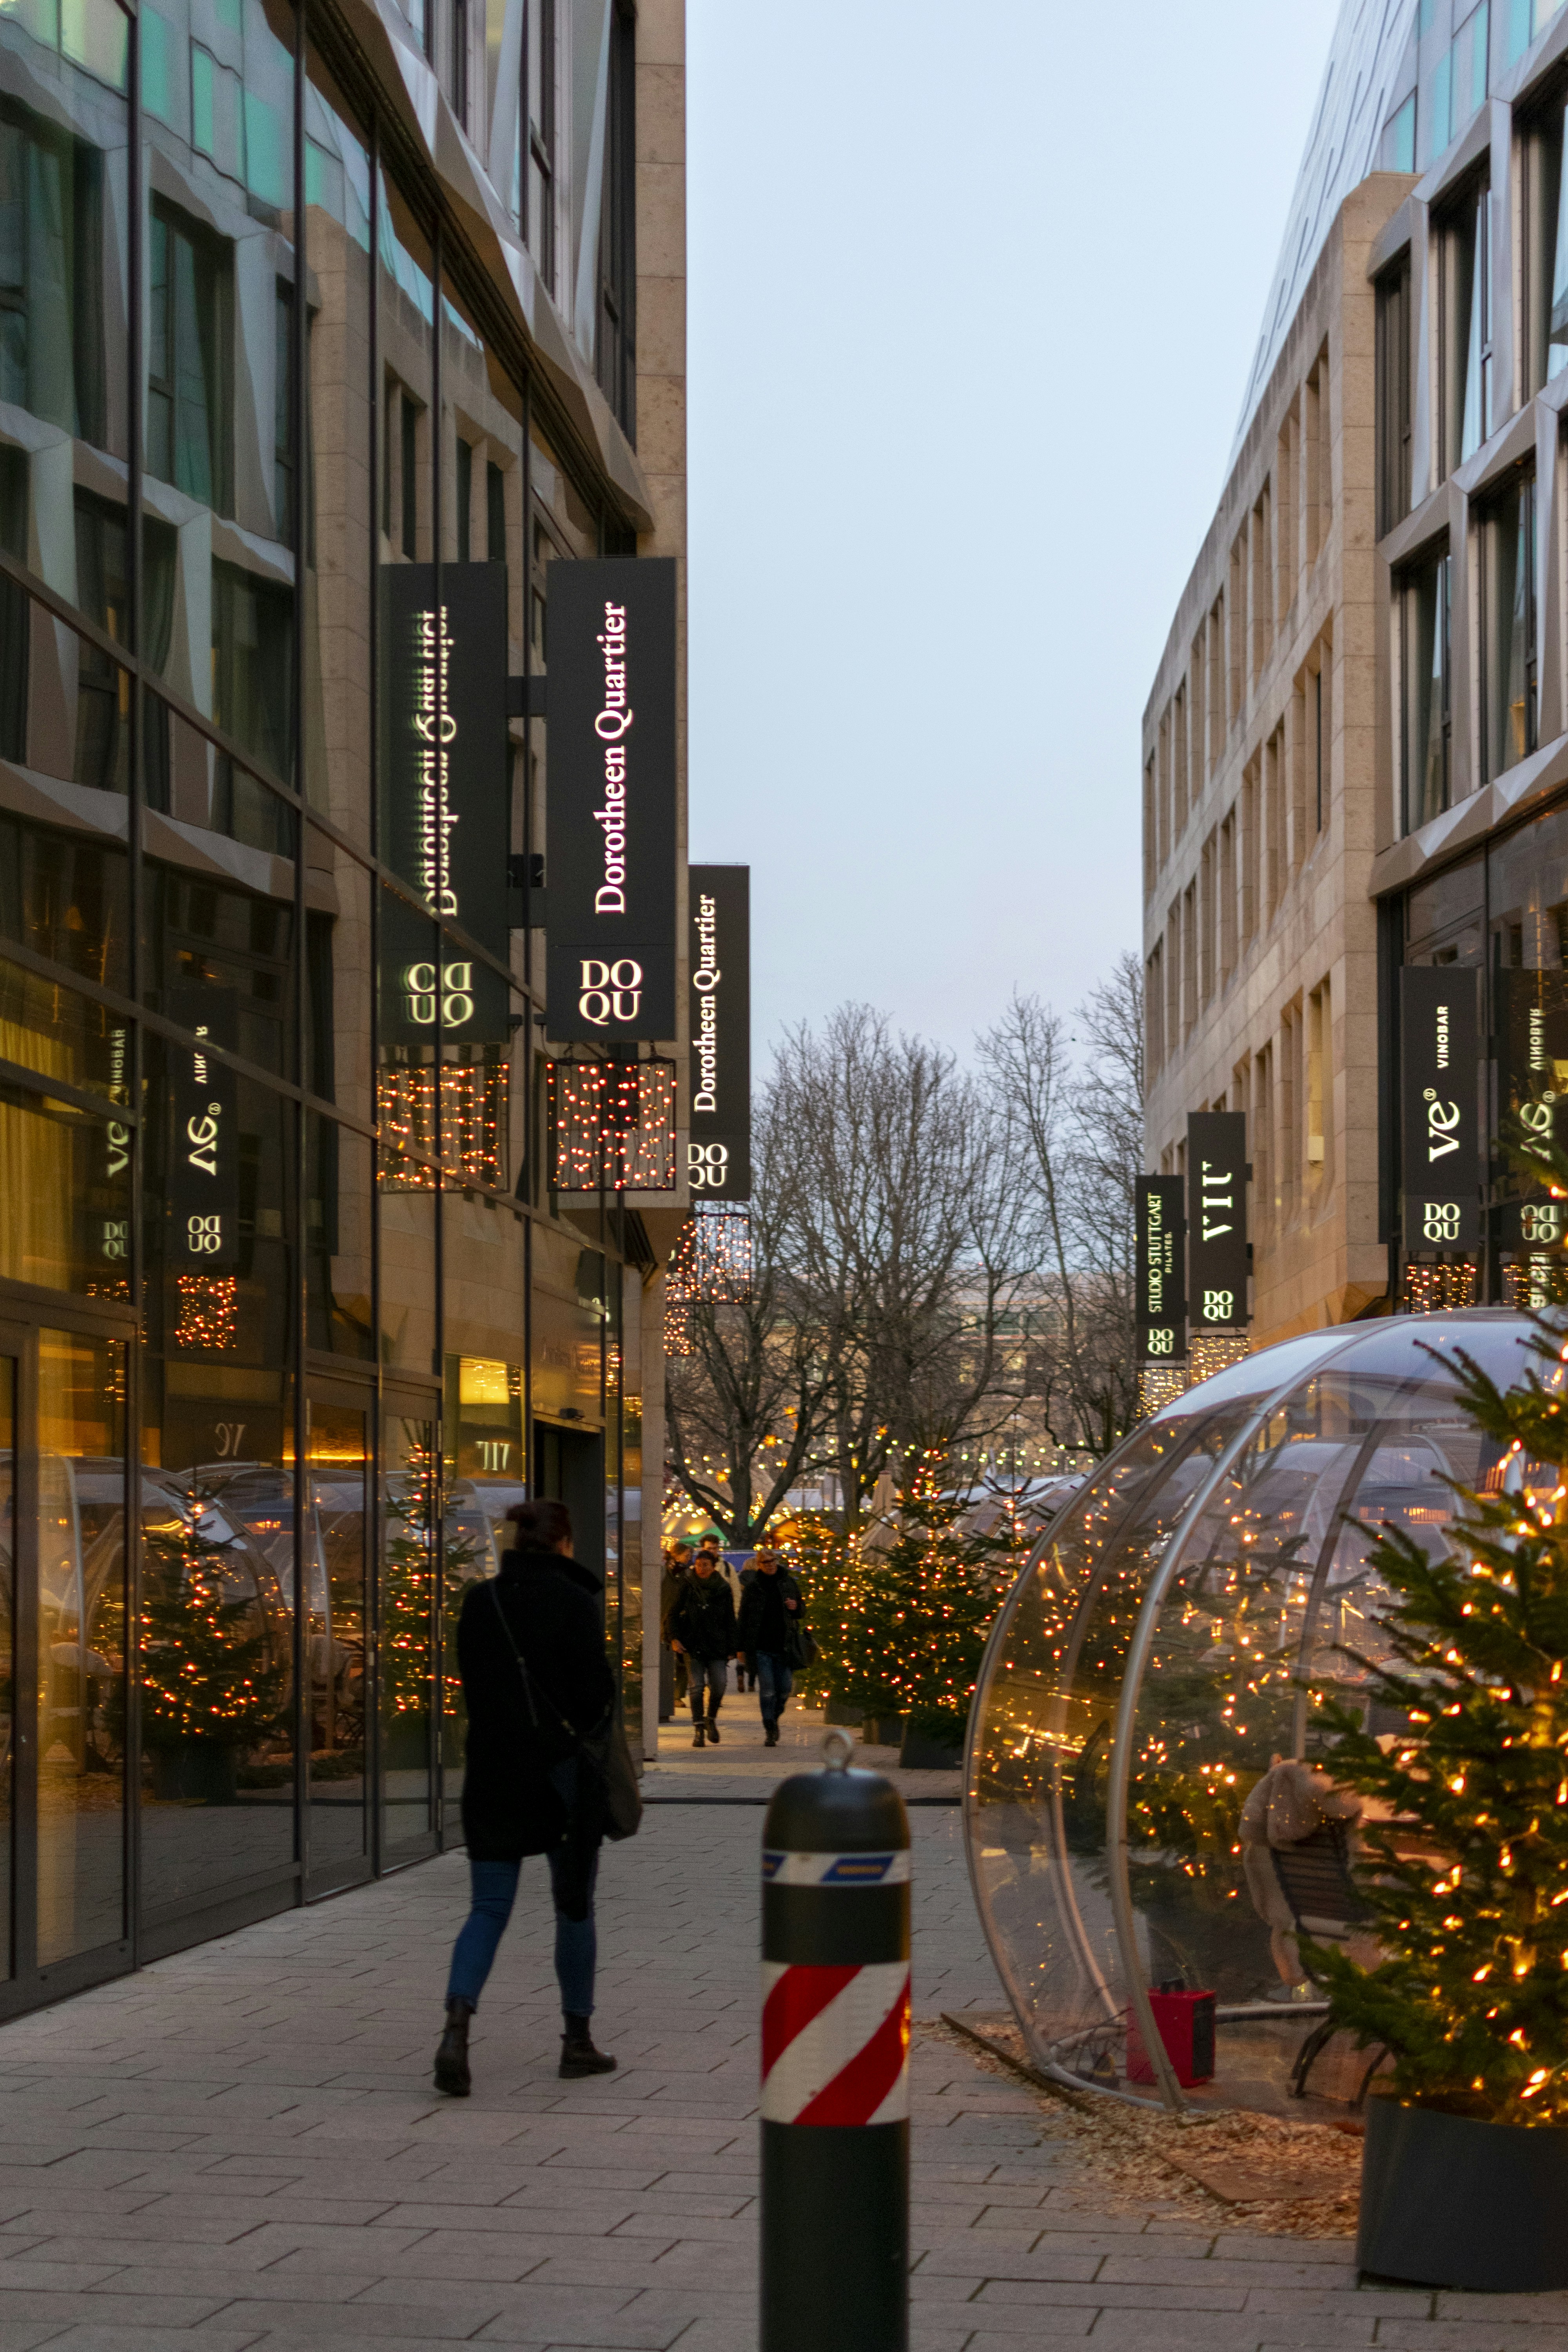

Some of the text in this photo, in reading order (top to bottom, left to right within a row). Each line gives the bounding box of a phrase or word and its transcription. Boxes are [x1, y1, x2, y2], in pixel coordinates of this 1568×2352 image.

[593, 602, 632, 914] Dorotheen Quartier
[580, 959, 641, 989] DO
[579, 990, 642, 1025] QU
[693, 894, 720, 1112] Dorotheen Quartier
[1437, 1006, 1449, 1068] VINOBAR
[1424, 1203, 1460, 1221] DO
[1423, 1221, 1460, 1242] QU
[1147, 1192, 1162, 1312] STUDIO STUTTGART
[1204, 1290, 1234, 1305] DO
[1203, 1304, 1233, 1321] QU
[1148, 1328, 1174, 1341] DO
[1148, 1341, 1173, 1355] QU
